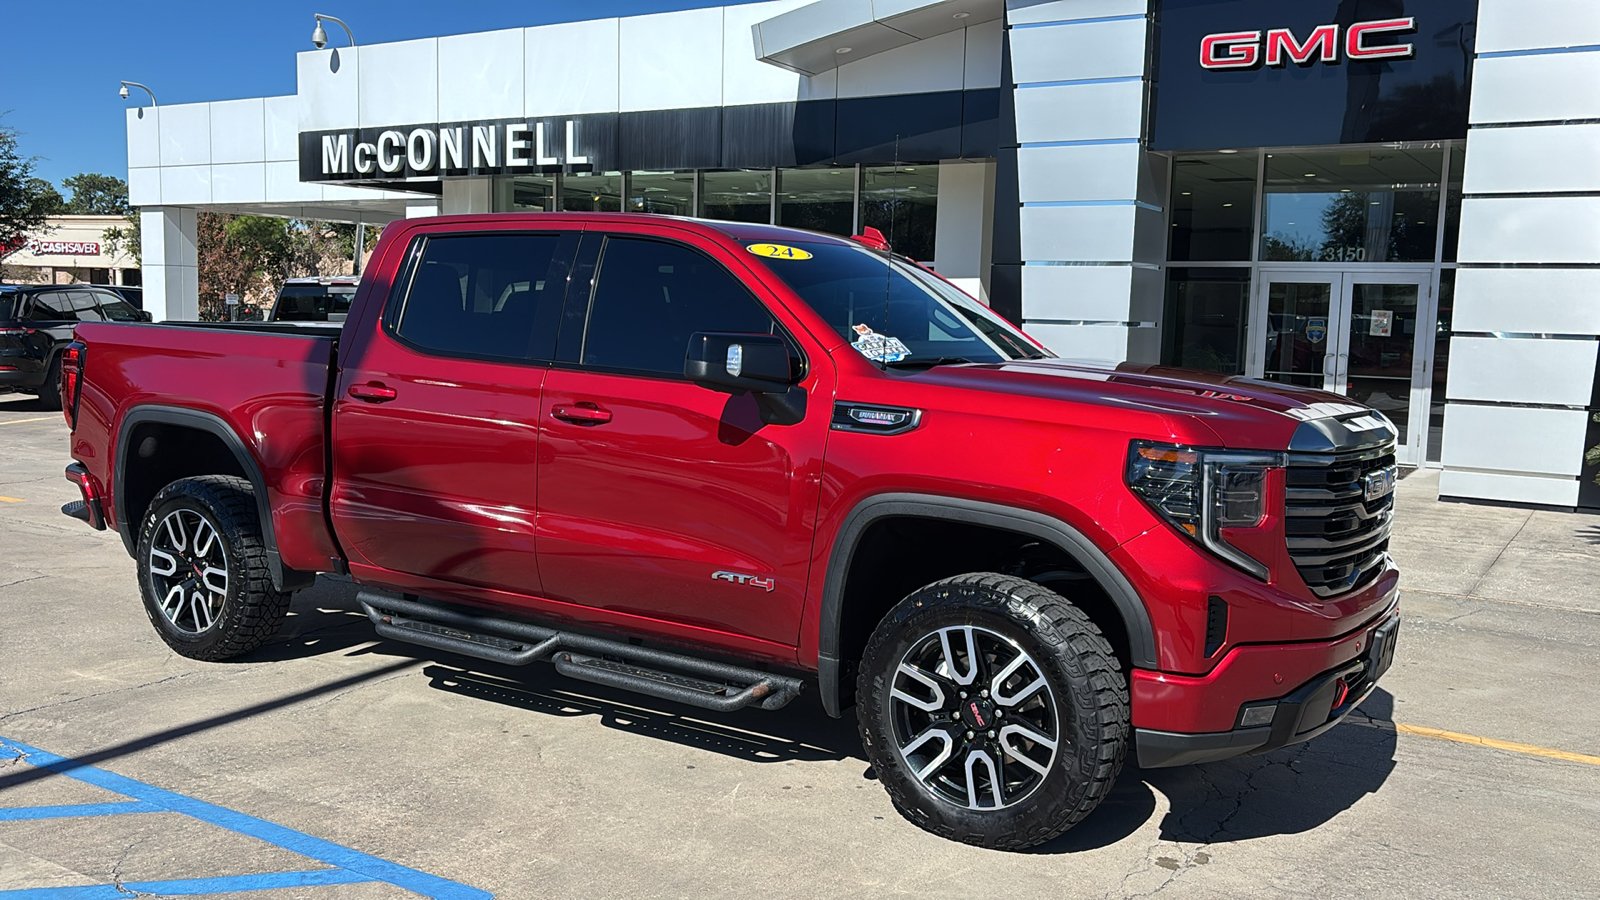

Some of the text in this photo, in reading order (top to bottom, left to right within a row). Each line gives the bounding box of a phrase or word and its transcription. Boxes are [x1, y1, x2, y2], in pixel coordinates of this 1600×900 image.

[1200, 17, 1416, 69] GMC
[321, 120, 588, 175] McCONNELL
[766, 246, 795, 258] 24
[1325, 247, 1366, 261] 3150
[711, 570, 775, 592] AT4
[970, 702, 985, 726] GMC
